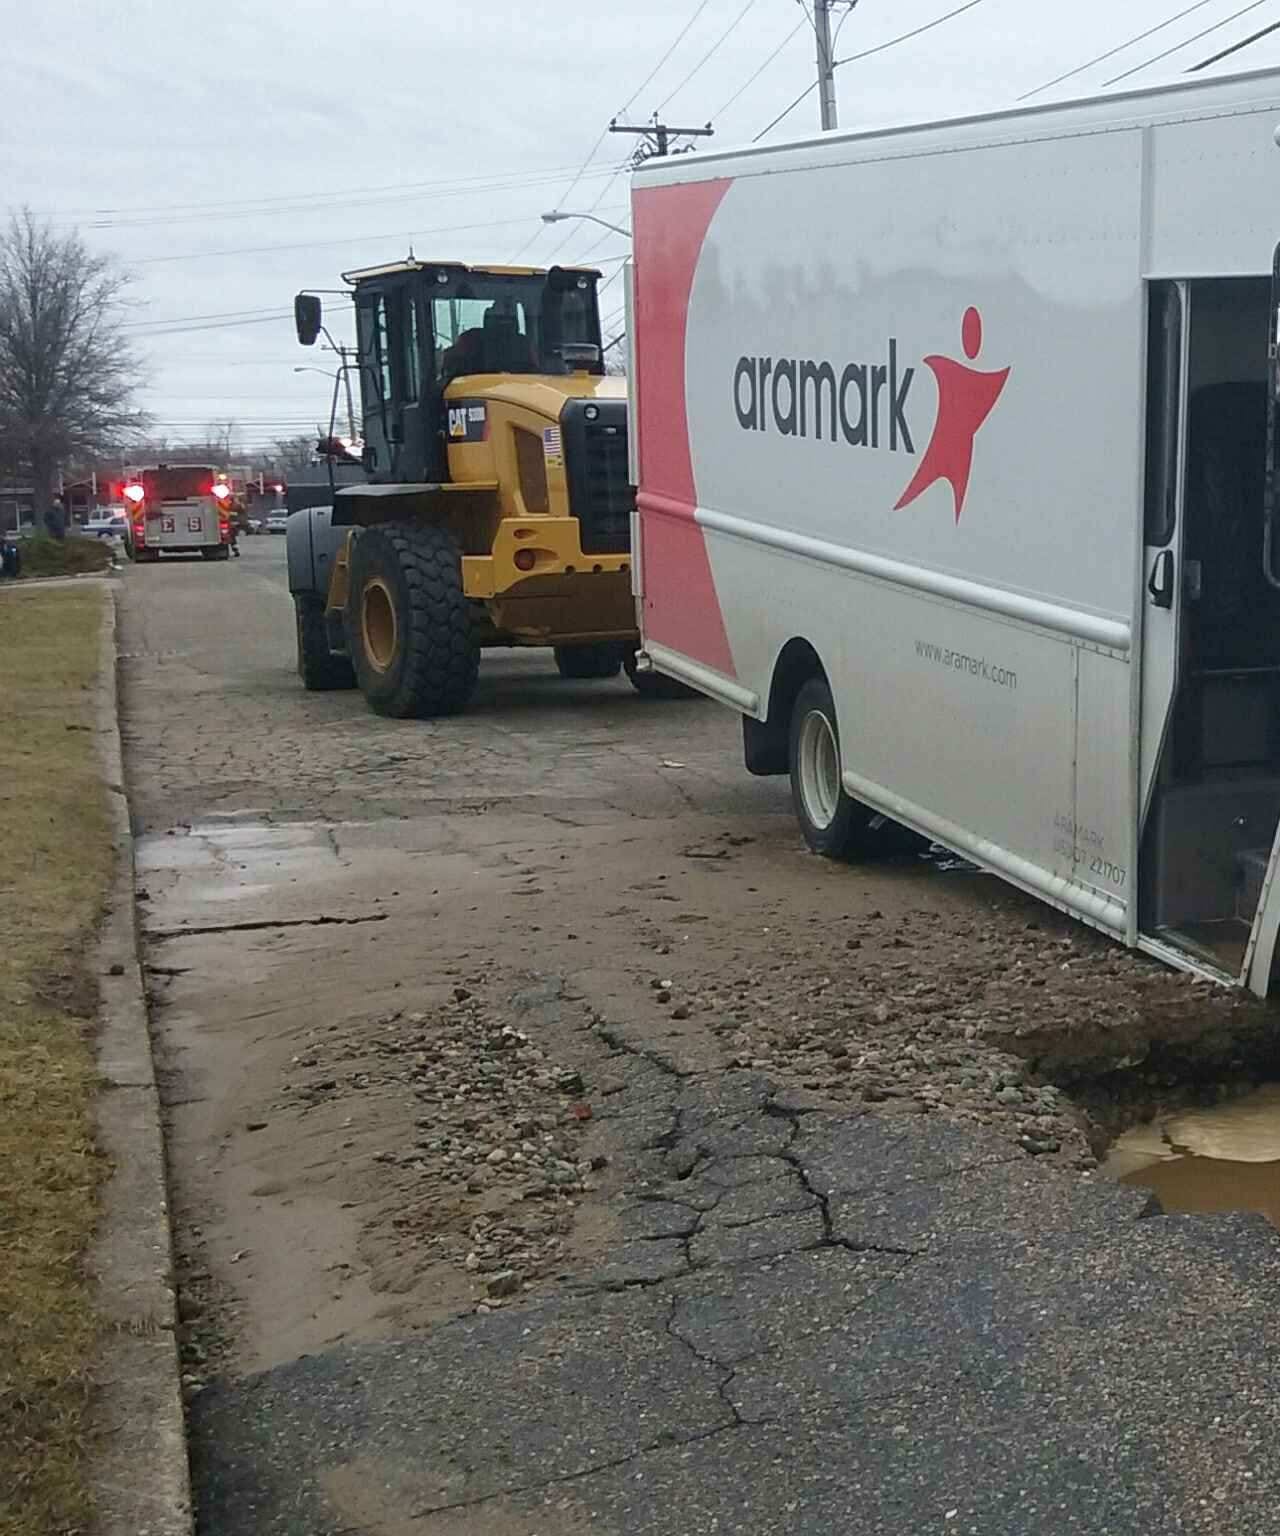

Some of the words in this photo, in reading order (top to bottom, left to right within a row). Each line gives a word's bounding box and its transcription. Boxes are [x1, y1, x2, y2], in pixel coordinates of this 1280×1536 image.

[733, 337, 916, 454] aramark
[448, 408, 467, 436] CAT
[913, 639, 1018, 689] www.aramark.com
[1089, 855, 1127, 887] 221707
